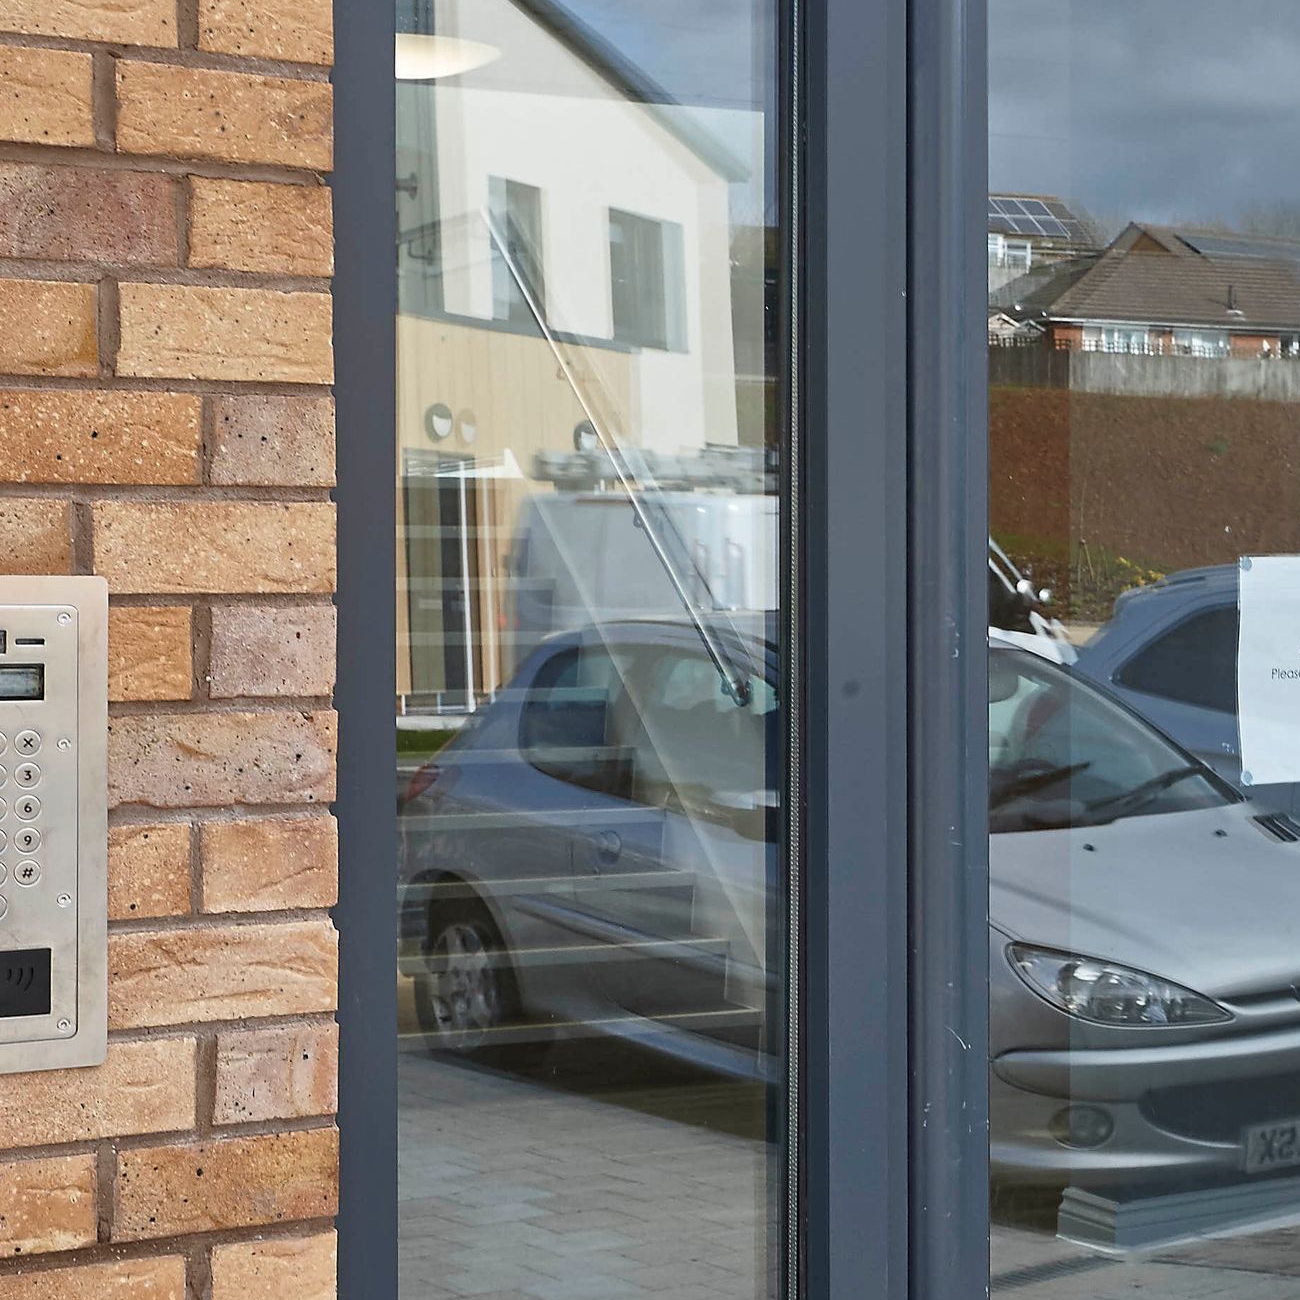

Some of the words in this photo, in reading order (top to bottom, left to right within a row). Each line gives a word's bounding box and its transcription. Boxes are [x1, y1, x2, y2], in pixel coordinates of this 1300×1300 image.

[24, 770, 32, 781] 3
[24, 802, 32, 813] 6
[24, 835, 32, 846] 9
